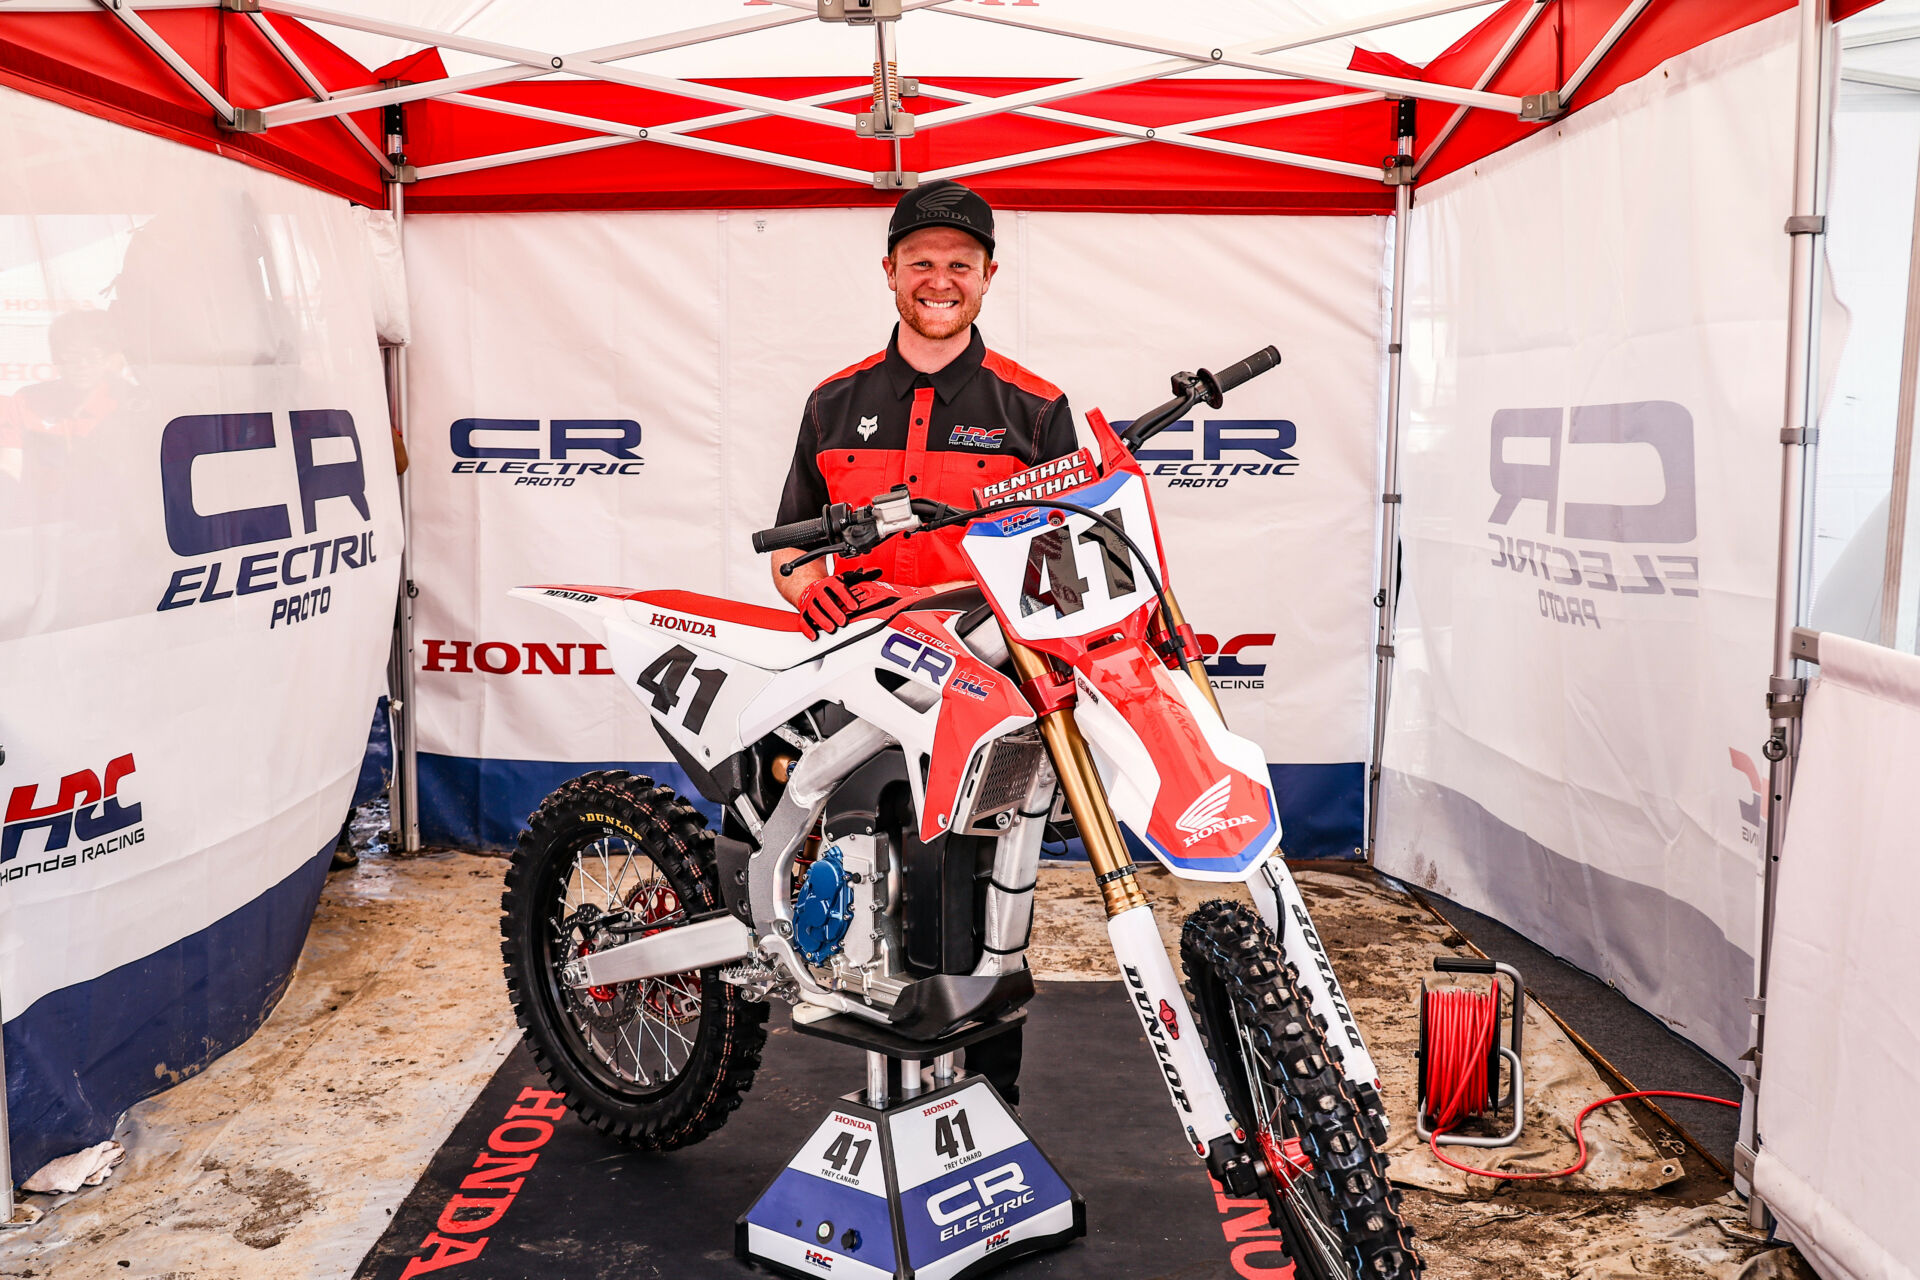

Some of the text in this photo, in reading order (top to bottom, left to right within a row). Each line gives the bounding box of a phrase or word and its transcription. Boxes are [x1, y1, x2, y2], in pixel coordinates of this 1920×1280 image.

[916, 211, 971, 224] HONDA
[450, 418, 645, 460] CR
[949, 425, 1006, 444] HRC
[1109, 419, 1300, 461] CR
[160, 409, 371, 557] CR
[451, 461, 645, 475] ELECTRIC
[514, 477, 576, 487] PROTO
[983, 454, 1086, 498] RENTHAL
[1167, 478, 1229, 488] PROTO
[156, 530, 377, 611] ELECTRIC
[1019, 507, 1137, 620] 41
[270, 585, 331, 629] PROTO
[544, 589, 598, 604] DUNLOP
[650, 613, 717, 638] HONDA
[903, 626, 952, 651] ELECTRIC
[880, 632, 953, 686] CR
[637, 643, 729, 736] 41
[1210, 680, 1265, 690] ACING
[0, 752, 143, 865] HRC
[585, 812, 643, 841] DUNLOP
[1182, 814, 1257, 848] HONDA
[0, 827, 145, 887] Honda RACING
[1291, 904, 1365, 1051] DUNLOP
[1123, 963, 1193, 1113] DUNLOP
[834, 1114, 872, 1132] HONDA
[922, 1099, 959, 1117] HONDA
[822, 1131, 872, 1177] 41
[935, 1108, 976, 1159] 41
[821, 1168, 860, 1186] TREY CANARD
[944, 1150, 982, 1171] TREY CANARD
[398, 1085, 568, 1280] HONDA
[926, 1161, 1032, 1227] CR
[940, 1189, 1035, 1242] ELECTRIC
[981, 1216, 1005, 1233] PROTO
